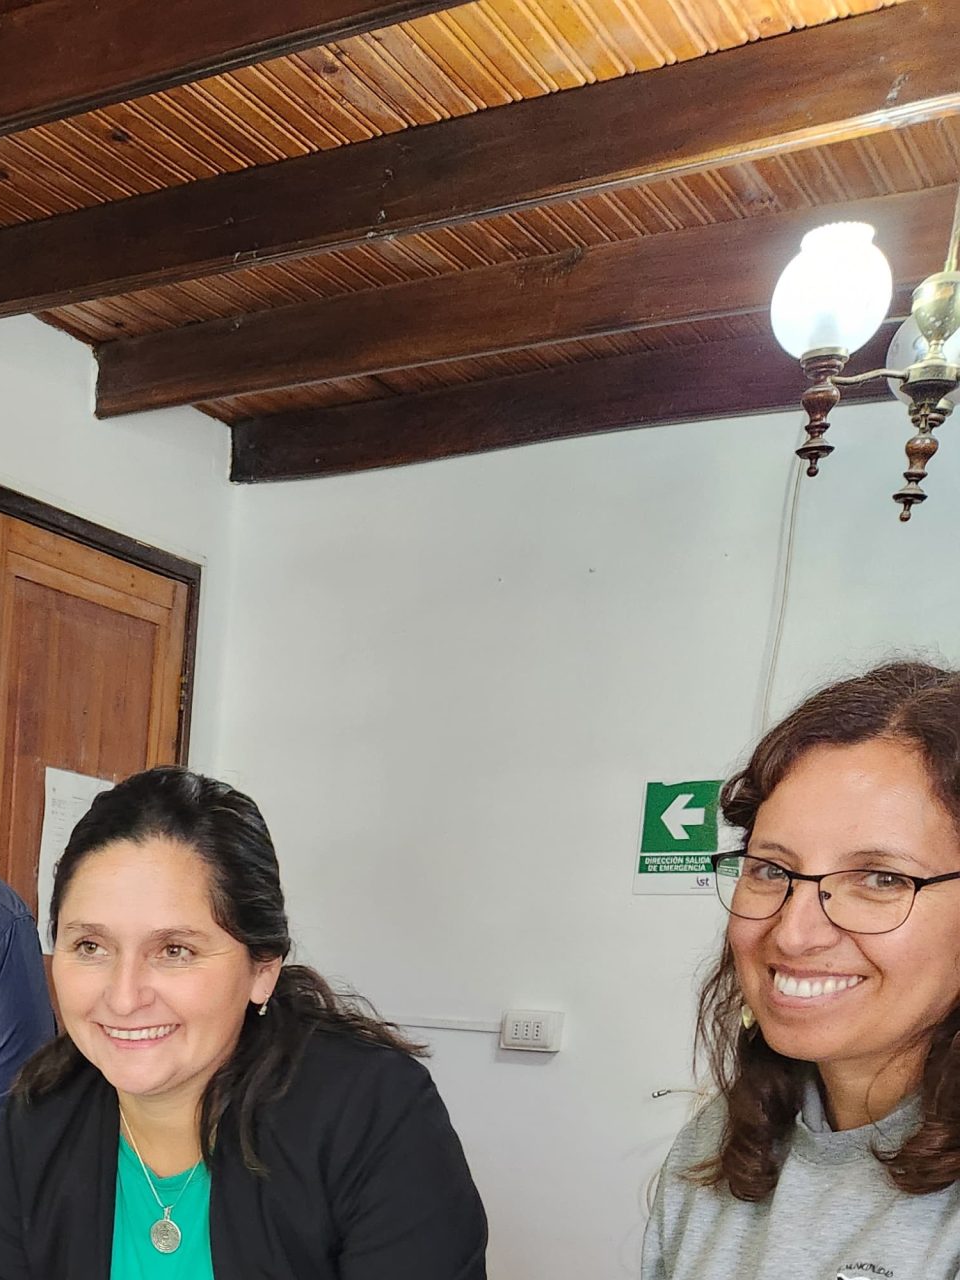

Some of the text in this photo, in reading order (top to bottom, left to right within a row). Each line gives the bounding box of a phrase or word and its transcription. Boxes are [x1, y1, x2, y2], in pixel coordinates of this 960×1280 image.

[685, 856, 712, 864] SALIDA
[648, 864, 706, 872] DE EMERGENCIA
